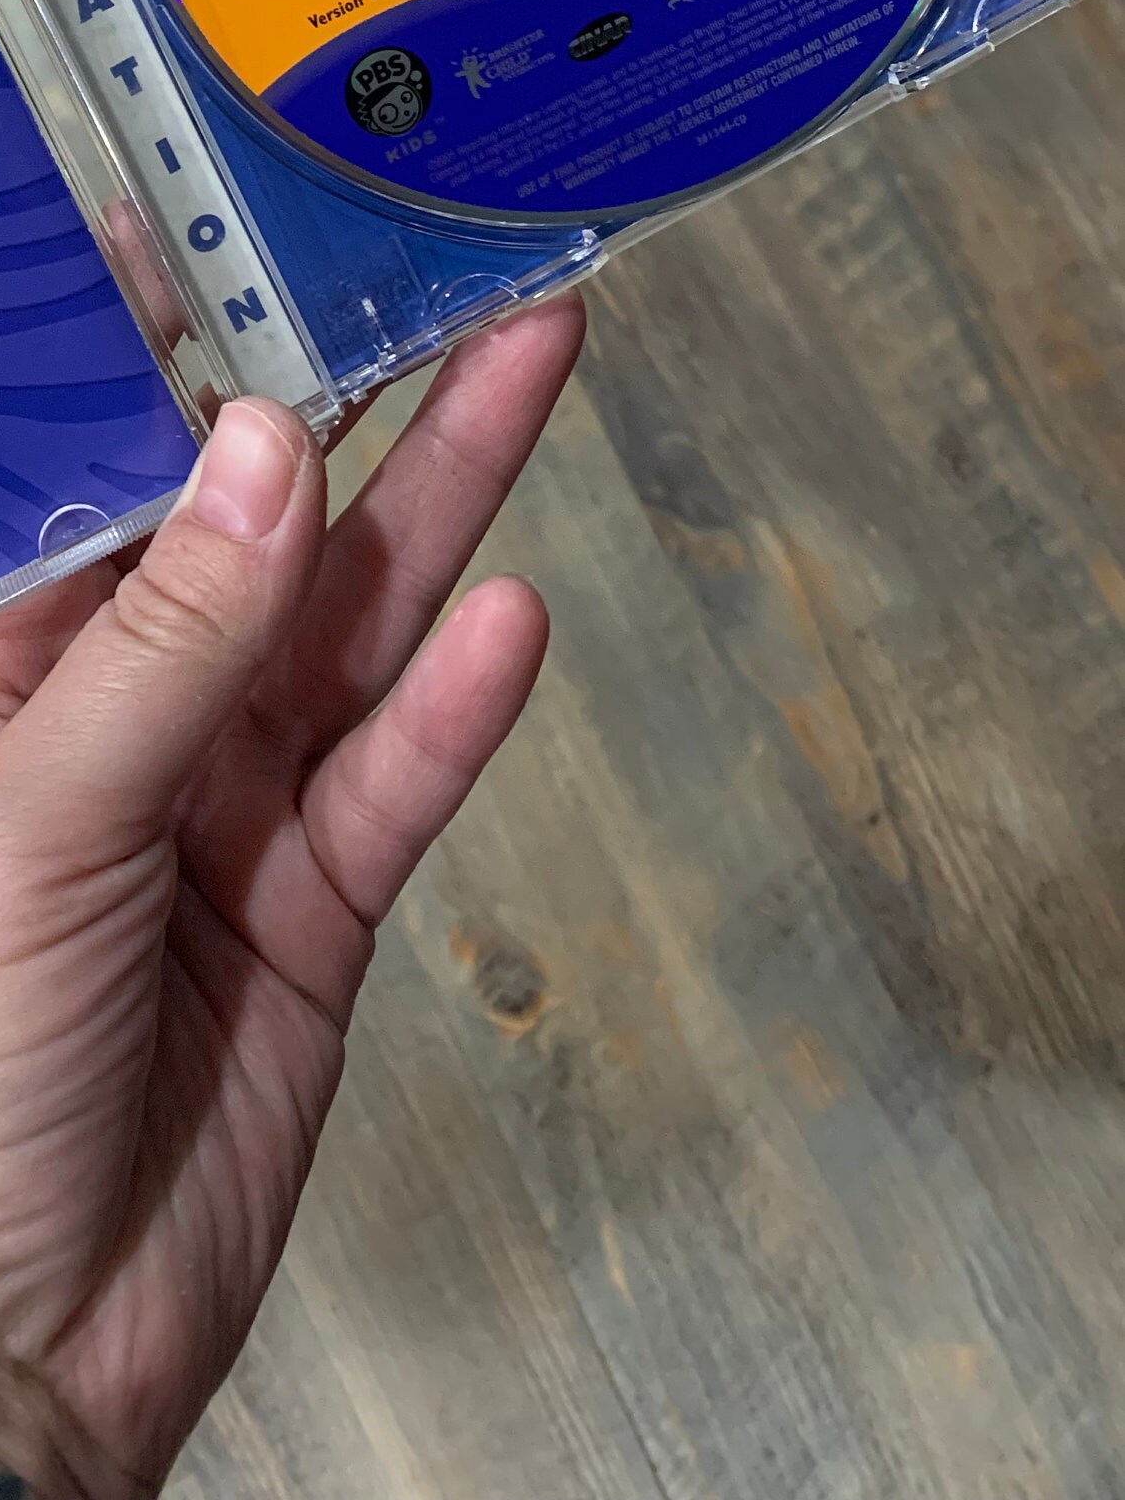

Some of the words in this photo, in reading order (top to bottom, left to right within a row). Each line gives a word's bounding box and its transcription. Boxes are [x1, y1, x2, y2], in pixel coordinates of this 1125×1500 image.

[732, 48, 802, 91] RESTRICTIONS
[822, 8, 883, 46] LIMITATIONS
[355, 54, 405, 92] PBS
[386, 129, 437, 164] KIDS
